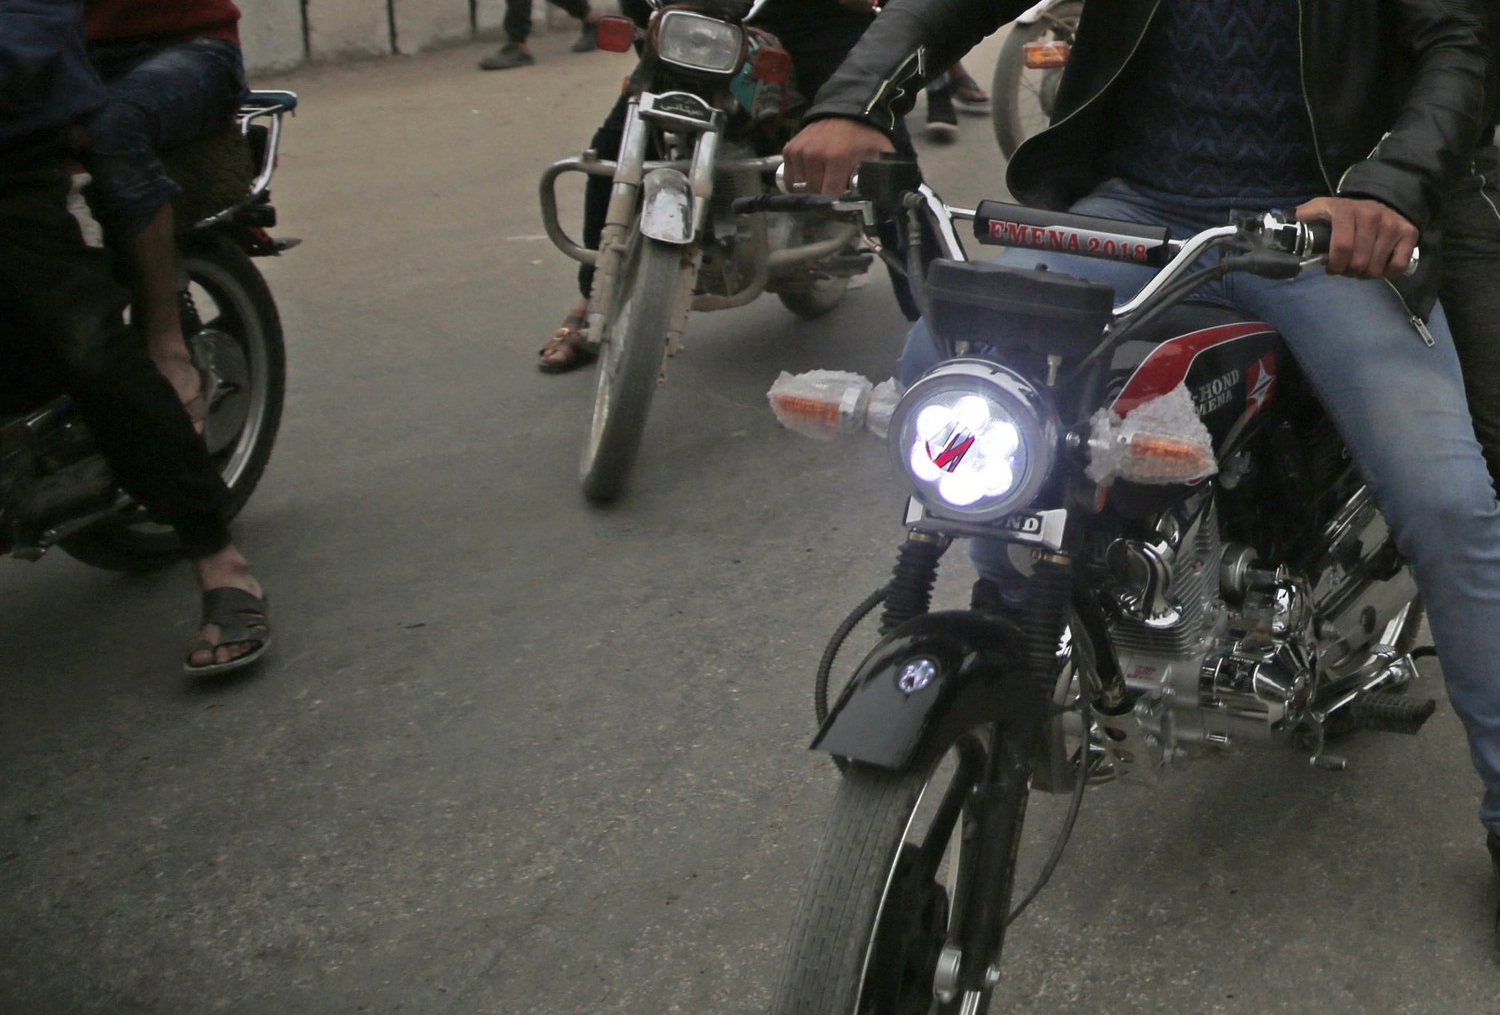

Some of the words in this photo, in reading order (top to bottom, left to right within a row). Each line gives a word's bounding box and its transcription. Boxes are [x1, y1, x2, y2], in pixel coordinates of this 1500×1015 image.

[988, 219, 1079, 252] EMENA
[1088, 237, 1148, 263] 2018
[1194, 390, 1232, 416] MENA
